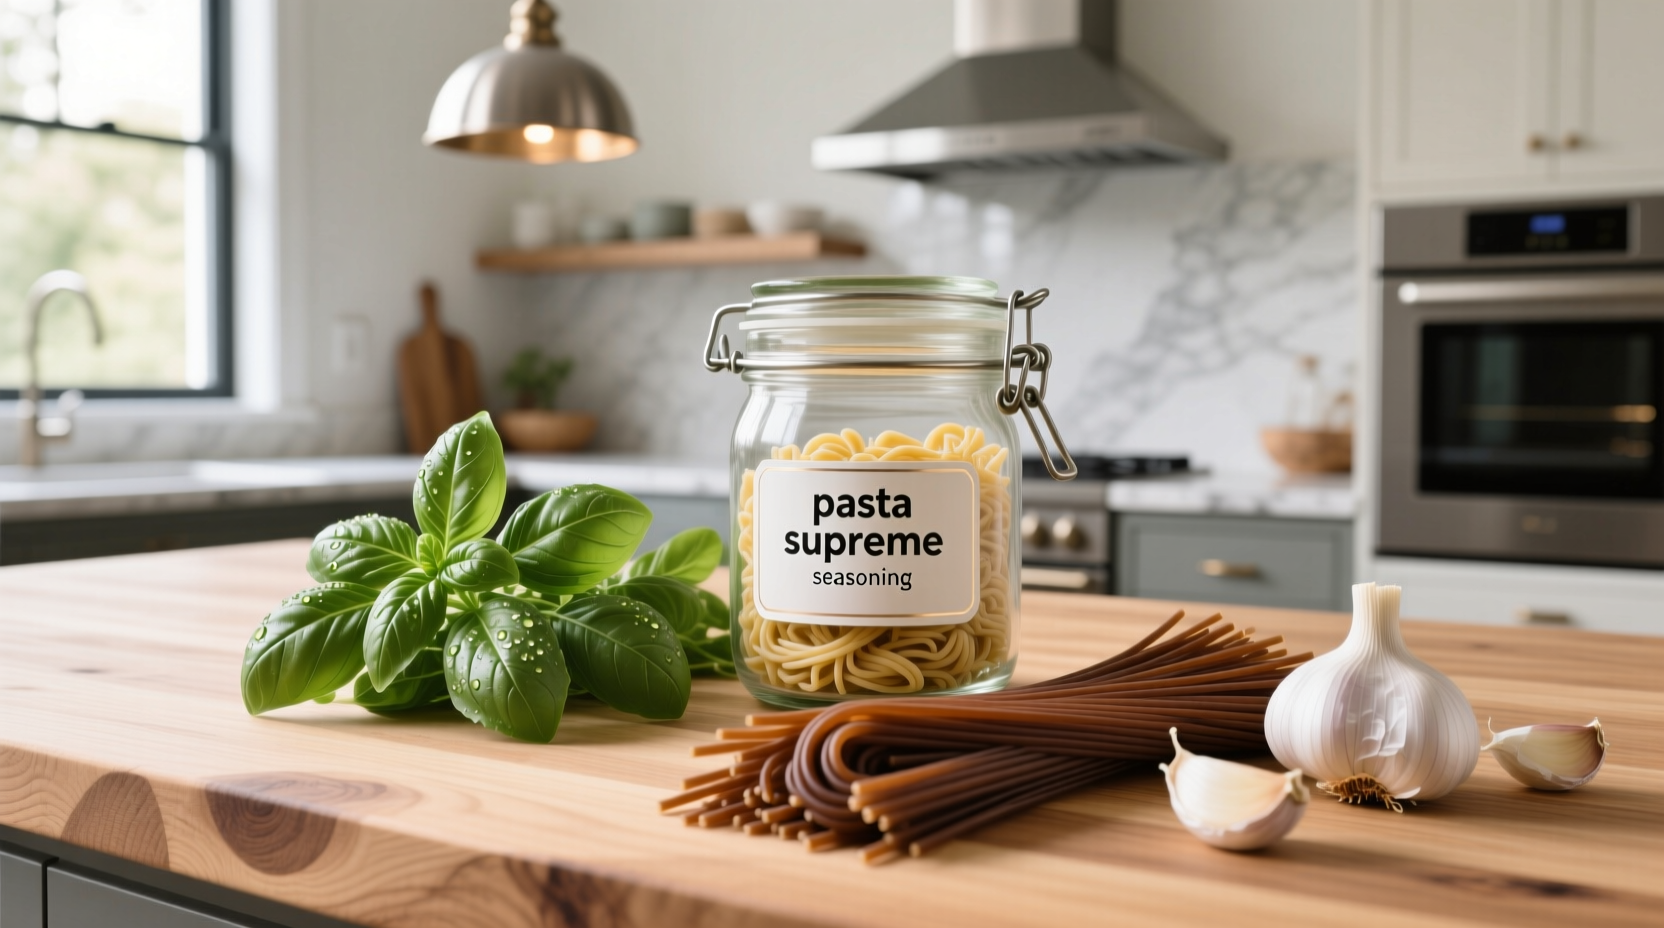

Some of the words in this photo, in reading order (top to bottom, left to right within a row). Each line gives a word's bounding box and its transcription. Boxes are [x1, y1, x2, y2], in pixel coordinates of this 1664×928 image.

[813, 488, 912, 526] pasta
[784, 531, 944, 563] supreme
[812, 567, 912, 591] seasoning
